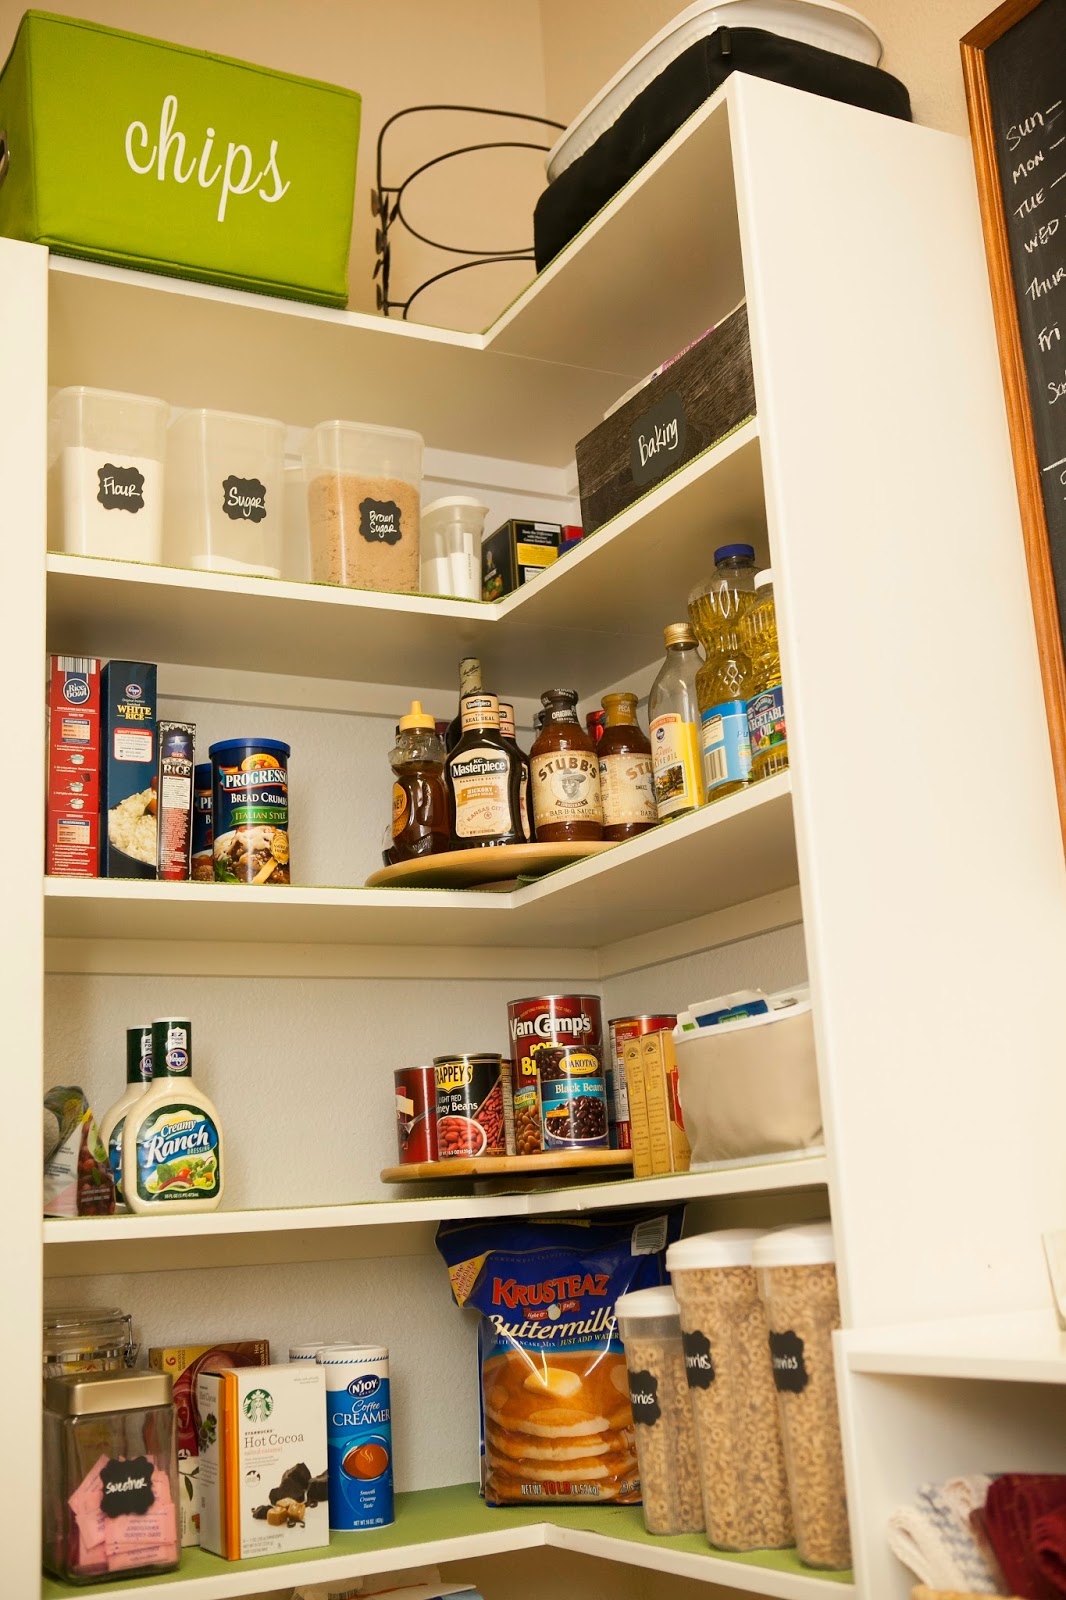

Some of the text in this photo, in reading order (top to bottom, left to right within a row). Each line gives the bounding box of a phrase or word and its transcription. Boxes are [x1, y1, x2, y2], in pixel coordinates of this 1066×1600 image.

[125, 95, 291, 222] chips
[1013, 188, 1046, 218] TUE
[1024, 219, 1059, 253] WED
[638, 418, 679, 466] Baking
[228, 487, 265, 517] Sugar
[369, 521, 397, 538] Sugar
[66, 687, 88, 699] bowl
[68, 683, 85, 691] Rice
[117, 705, 152, 715] WHITE
[749, 705, 784, 732] VEGETABL
[761, 724, 774, 737] OIL
[453, 761, 506, 777] Masterpiece
[538, 757, 597, 781] STUBB'S
[226, 769, 287, 788] PROGRESS
[231, 793, 259, 803] BREAD
[235, 811, 286, 821] ITALIAN STYLE
[510, 1013, 592, 1041] Van Camp's
[435, 1065, 473, 1086] RAPPEY'S
[555, 1083, 580, 1094] Black
[451, 1102, 478, 1111] Beans
[161, 1120, 196, 1137] Creamy
[143, 1124, 210, 1168] Ranch
[187, 1145, 210, 1155] DRESSING
[492, 1274, 609, 1308] KRUSTEAZ
[489, 1306, 617, 1340] Buttermilk
[560, 1338, 577, 1347] JUST
[351, 1399, 380, 1414] Coffee
[333, 1409, 390, 1427] CREAMER
[244, 1434, 304, 1448] Hot Cocoa
[543, 1481, 556, 1495] 10
[557, 1481, 571, 1495] LB
